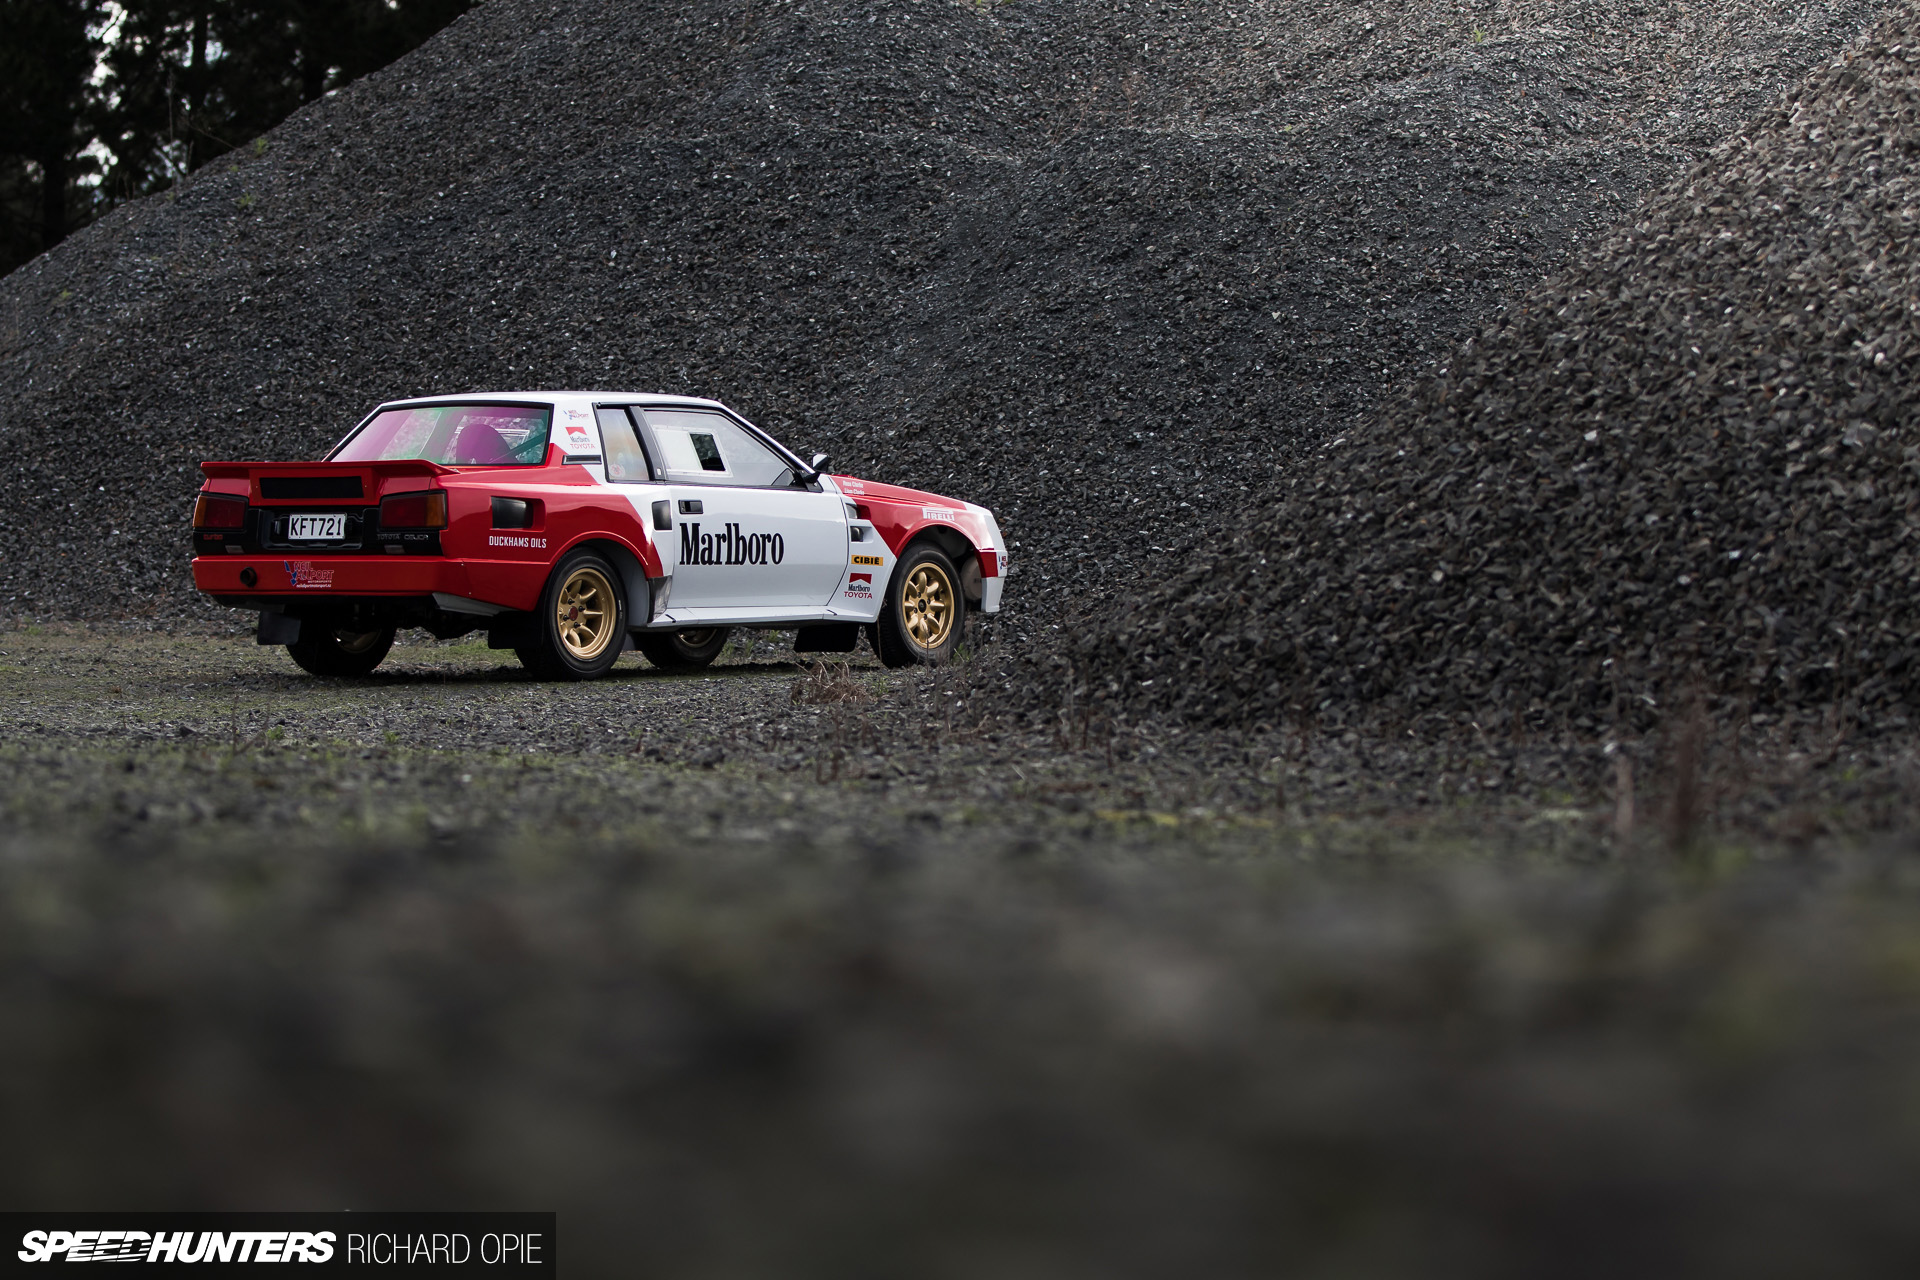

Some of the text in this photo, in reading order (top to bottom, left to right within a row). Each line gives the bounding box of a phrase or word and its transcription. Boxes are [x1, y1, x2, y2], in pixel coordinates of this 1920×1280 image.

[922, 507, 955, 521] PIRELLI
[290, 517, 342, 536] KFT721
[488, 535, 547, 549] DUCKHAMS OILS
[679, 522, 785, 566] Marlboro
[294, 561, 313, 571] NEIL
[844, 591, 873, 599] TOYOTA
[848, 584, 871, 592] Marlboro
